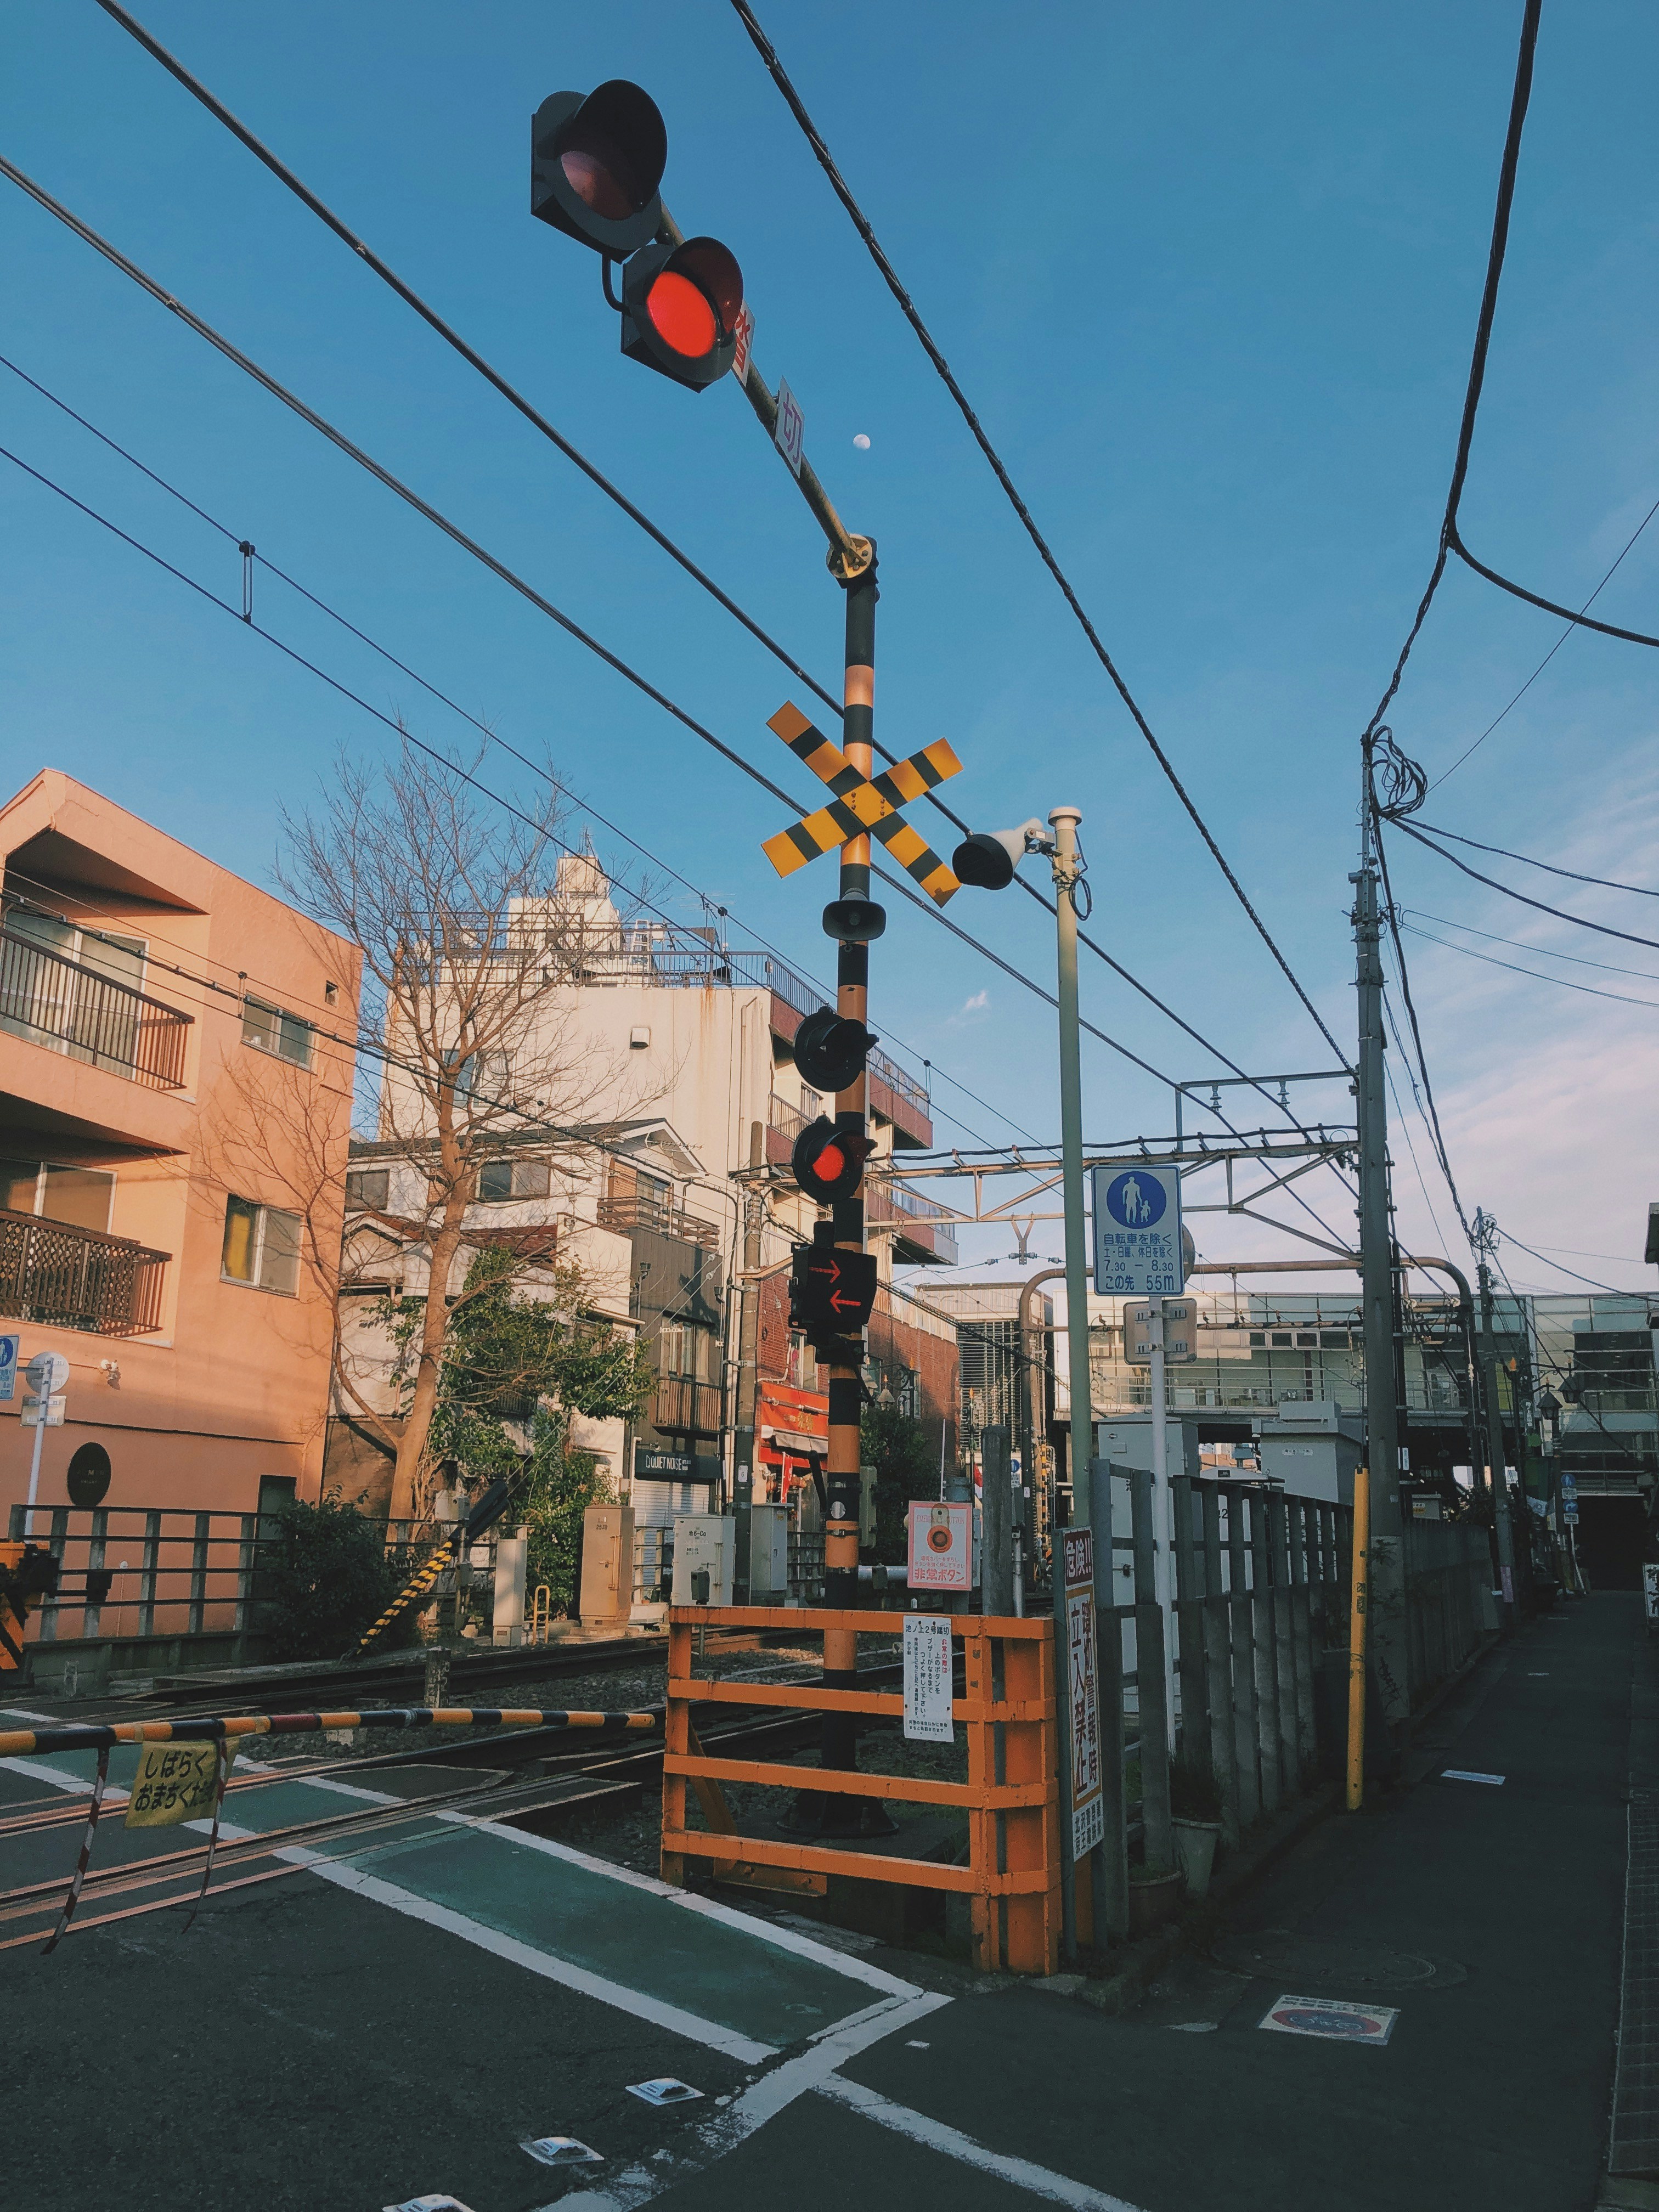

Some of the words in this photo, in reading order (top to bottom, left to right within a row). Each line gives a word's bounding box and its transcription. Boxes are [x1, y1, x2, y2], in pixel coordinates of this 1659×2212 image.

[783, 392, 802, 464] 切
[1104, 1233, 1172, 1245] 自転車を除く
[1104, 1260, 1125, 1271] 7.30
[1152, 1260, 1173, 1271] 8.30
[1105, 1276, 1134, 1290] この先
[1146, 1275, 1174, 1290] 55m
[651, 1455, 666, 1469] QUIET
[667, 1457, 682, 1470] NOISE
[915, 1567, 964, 1582] 非常ボタン
[906, 1624, 949, 1635] 池ノ上2号踏切
[1071, 1602, 1088, 1794] 立入禁止
[1081, 1599, 1098, 1784] 踏切警報時
[145, 1751, 207, 1779] しばらく
